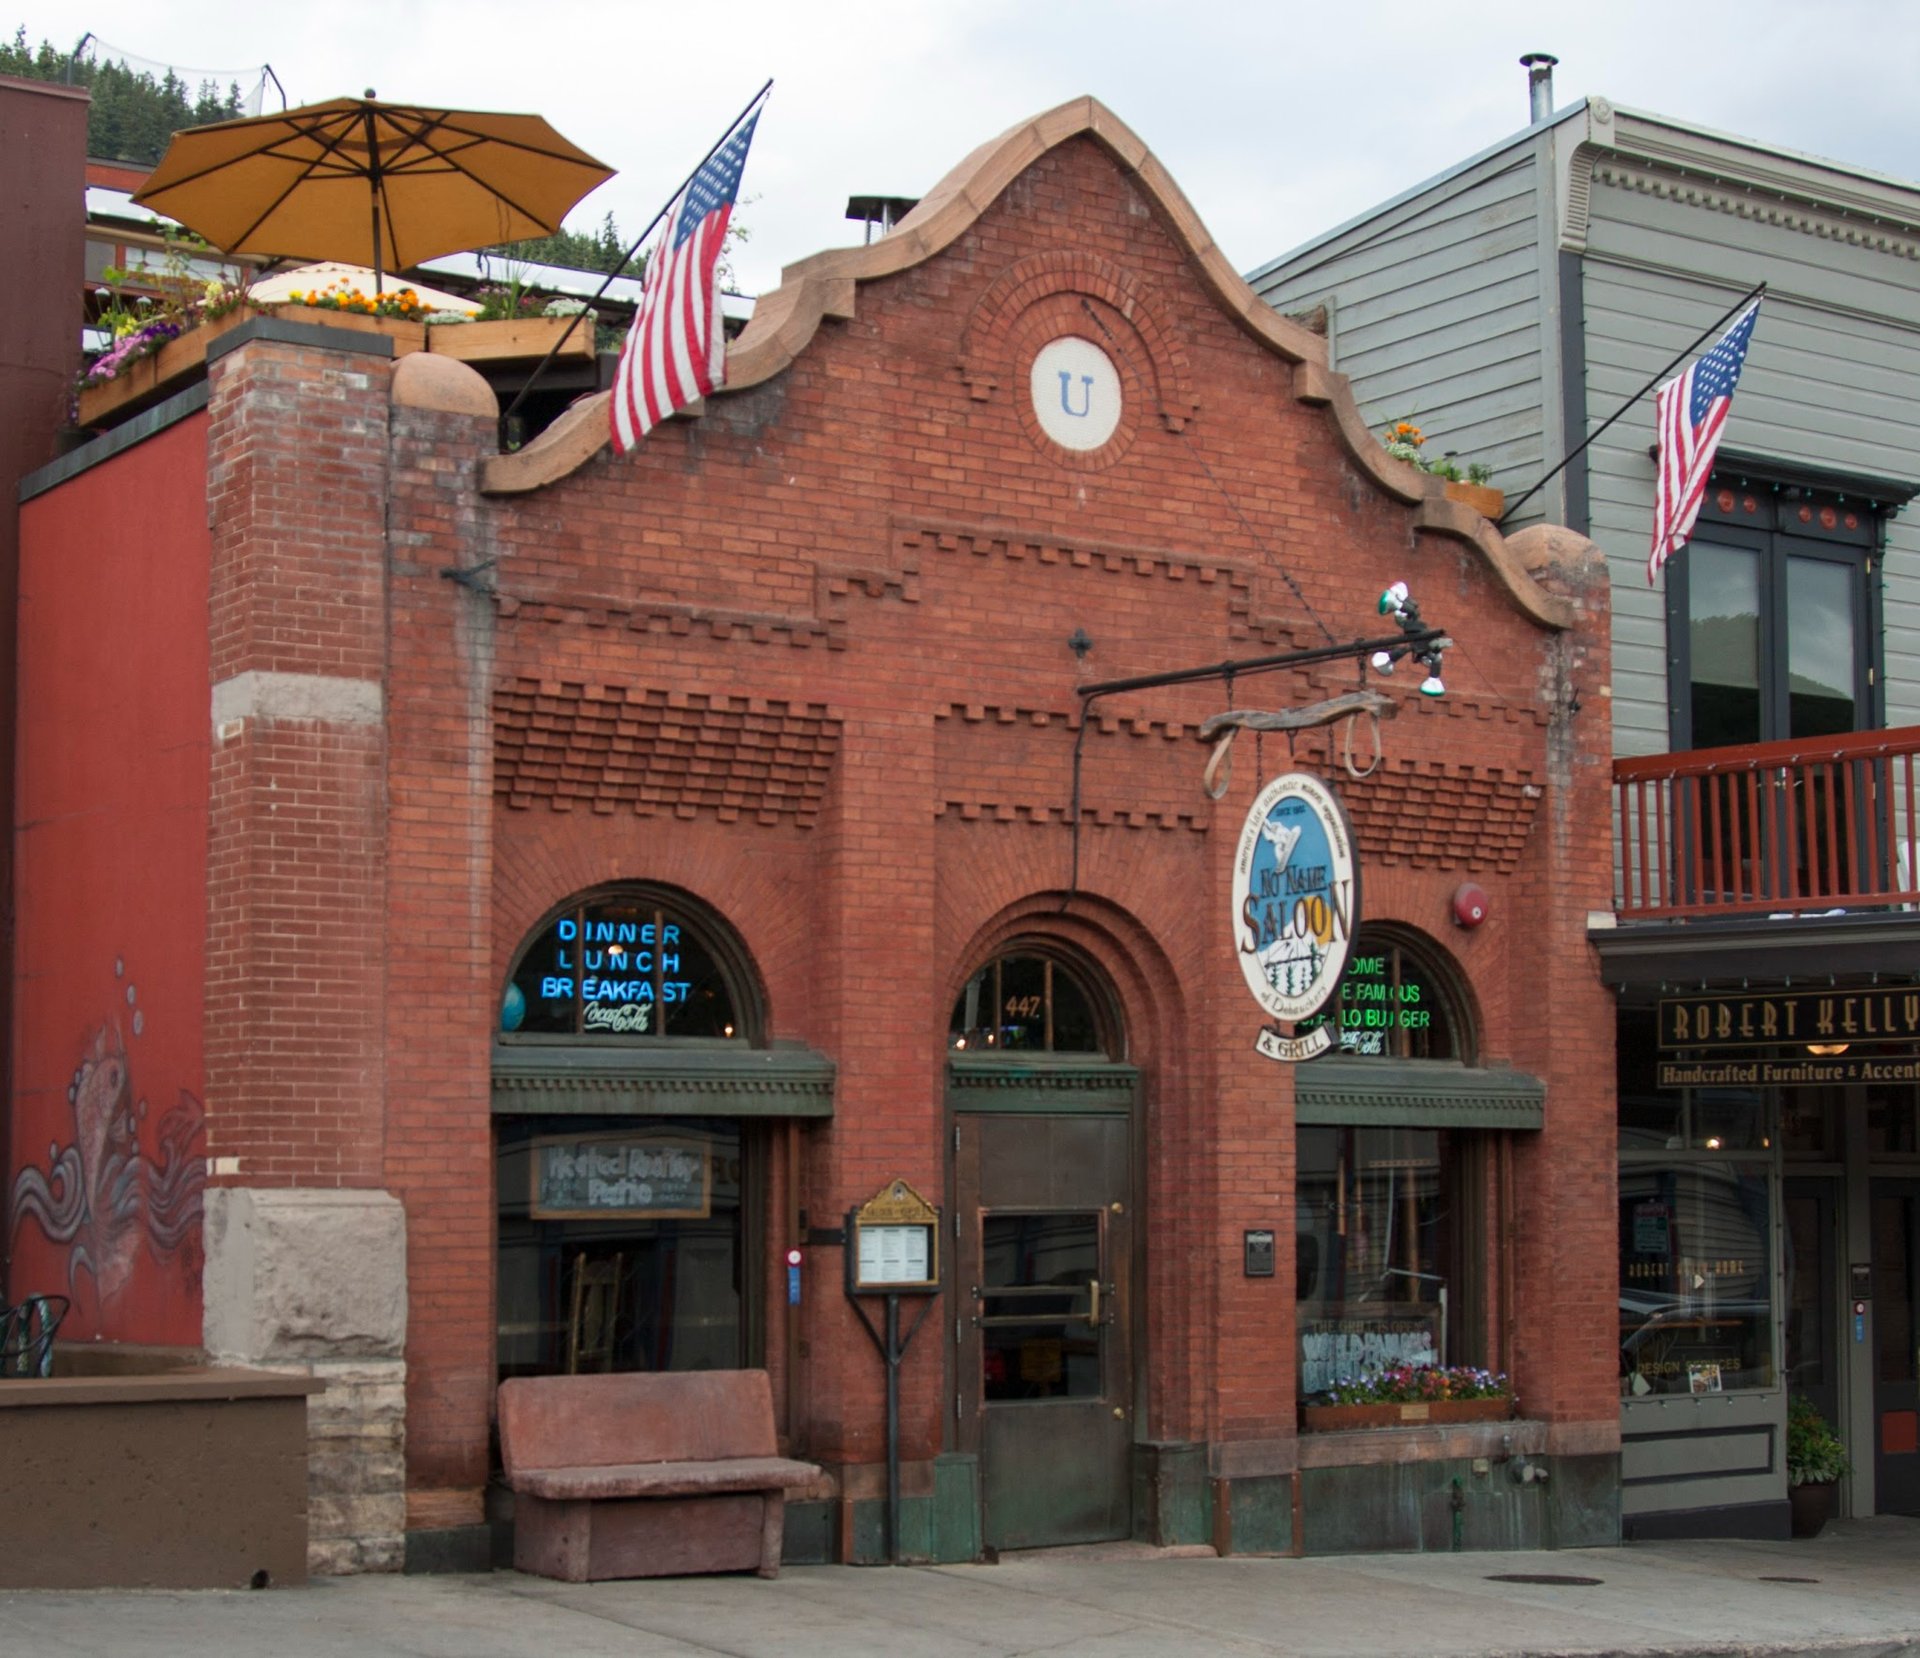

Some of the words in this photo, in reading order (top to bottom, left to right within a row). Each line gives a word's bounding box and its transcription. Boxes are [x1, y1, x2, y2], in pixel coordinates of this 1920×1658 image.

[1058, 371, 1094, 417] U
[1241, 879, 1351, 953] SALOON
[558, 919, 680, 945] DINNER
[558, 949, 680, 973] LUNCH
[1348, 958, 1385, 974] OME
[540, 977, 692, 1002] BREAKFAST
[1006, 996, 1040, 1017] 447
[1673, 1000, 1798, 1039] ROBERT
[1817, 995, 1919, 1035] KELLY
[1263, 1037, 1273, 1053] &
[1278, 1036, 1324, 1057] GRILL
[1663, 1064, 1758, 1083] Handcrafted
[1763, 1062, 1843, 1081] Furniture
[1847, 1064, 1857, 1077] &
[1638, 1361, 1680, 1374] DESIGN
